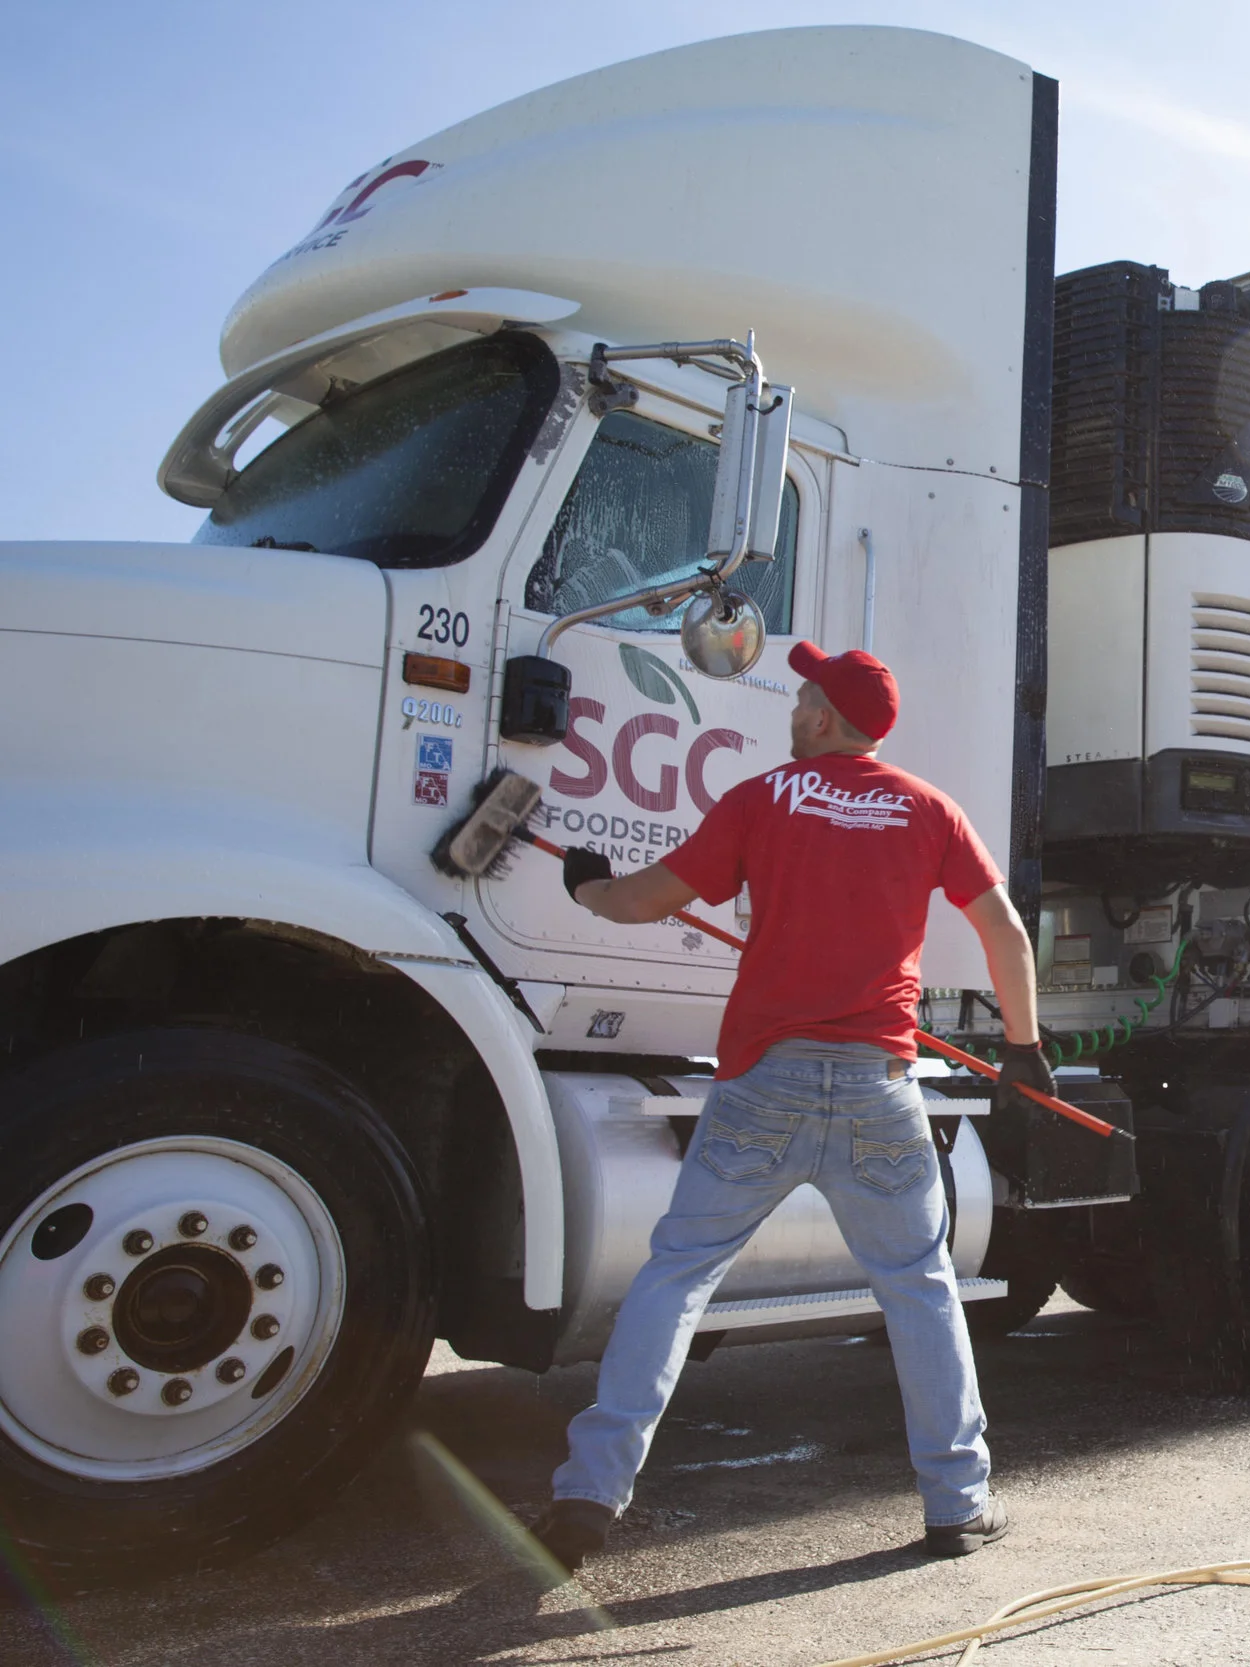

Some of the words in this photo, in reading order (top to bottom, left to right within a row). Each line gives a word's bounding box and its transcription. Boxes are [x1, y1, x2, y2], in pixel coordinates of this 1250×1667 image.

[416, 603, 470, 648] 230
[549, 696, 746, 813] SGC
[765, 770, 913, 815] Winder
[827, 803, 844, 813] and
[846, 807, 892, 818] Company
[545, 805, 694, 848] FOODSER
[585, 840, 656, 865] SINCE
